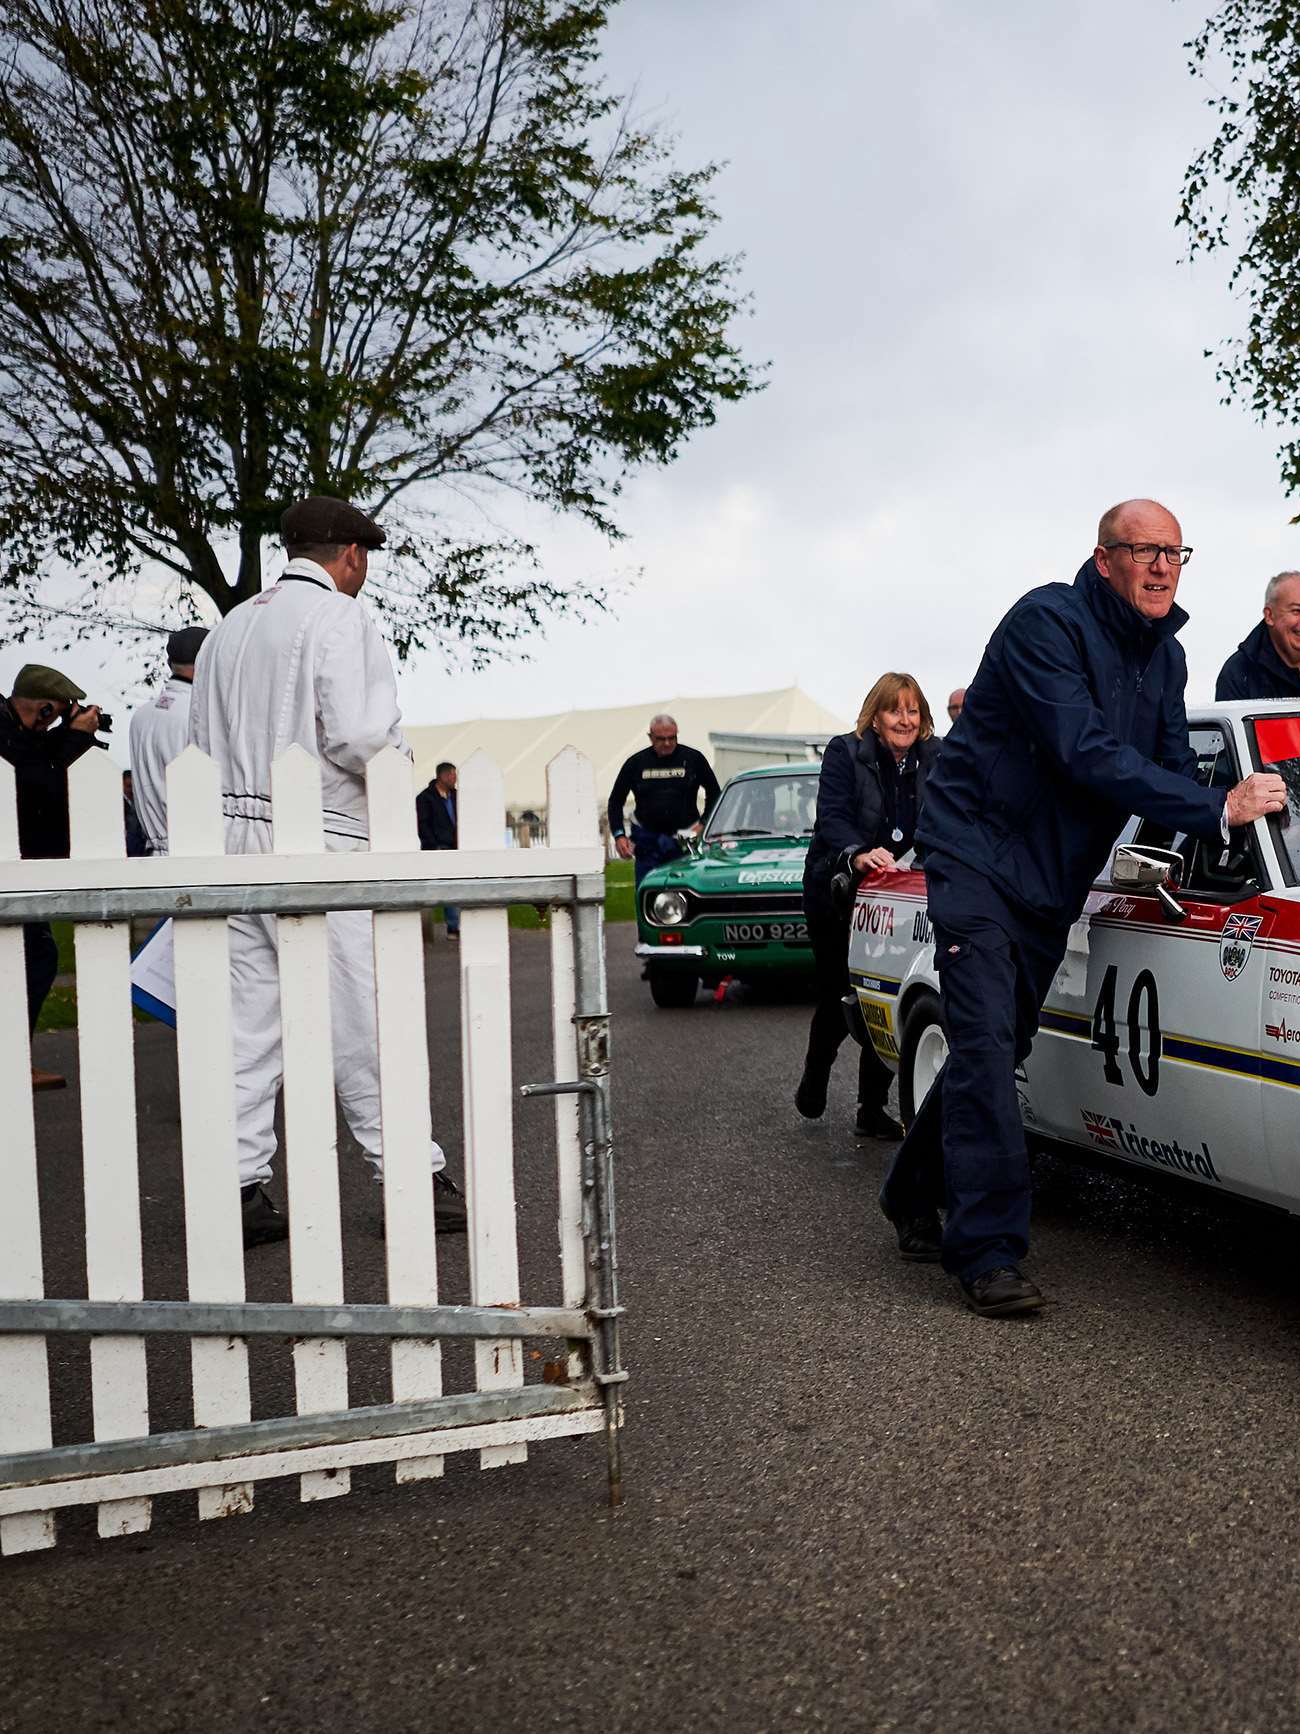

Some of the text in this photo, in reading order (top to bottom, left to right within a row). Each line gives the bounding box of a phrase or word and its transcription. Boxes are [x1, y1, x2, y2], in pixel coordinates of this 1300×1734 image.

[725, 923, 809, 940] NOO 922
[853, 902, 894, 937] TOYOTA
[716, 953, 736, 961] TOW
[1091, 964, 1162, 1097] 40
[1109, 1117, 1222, 1183] Tricentrol
